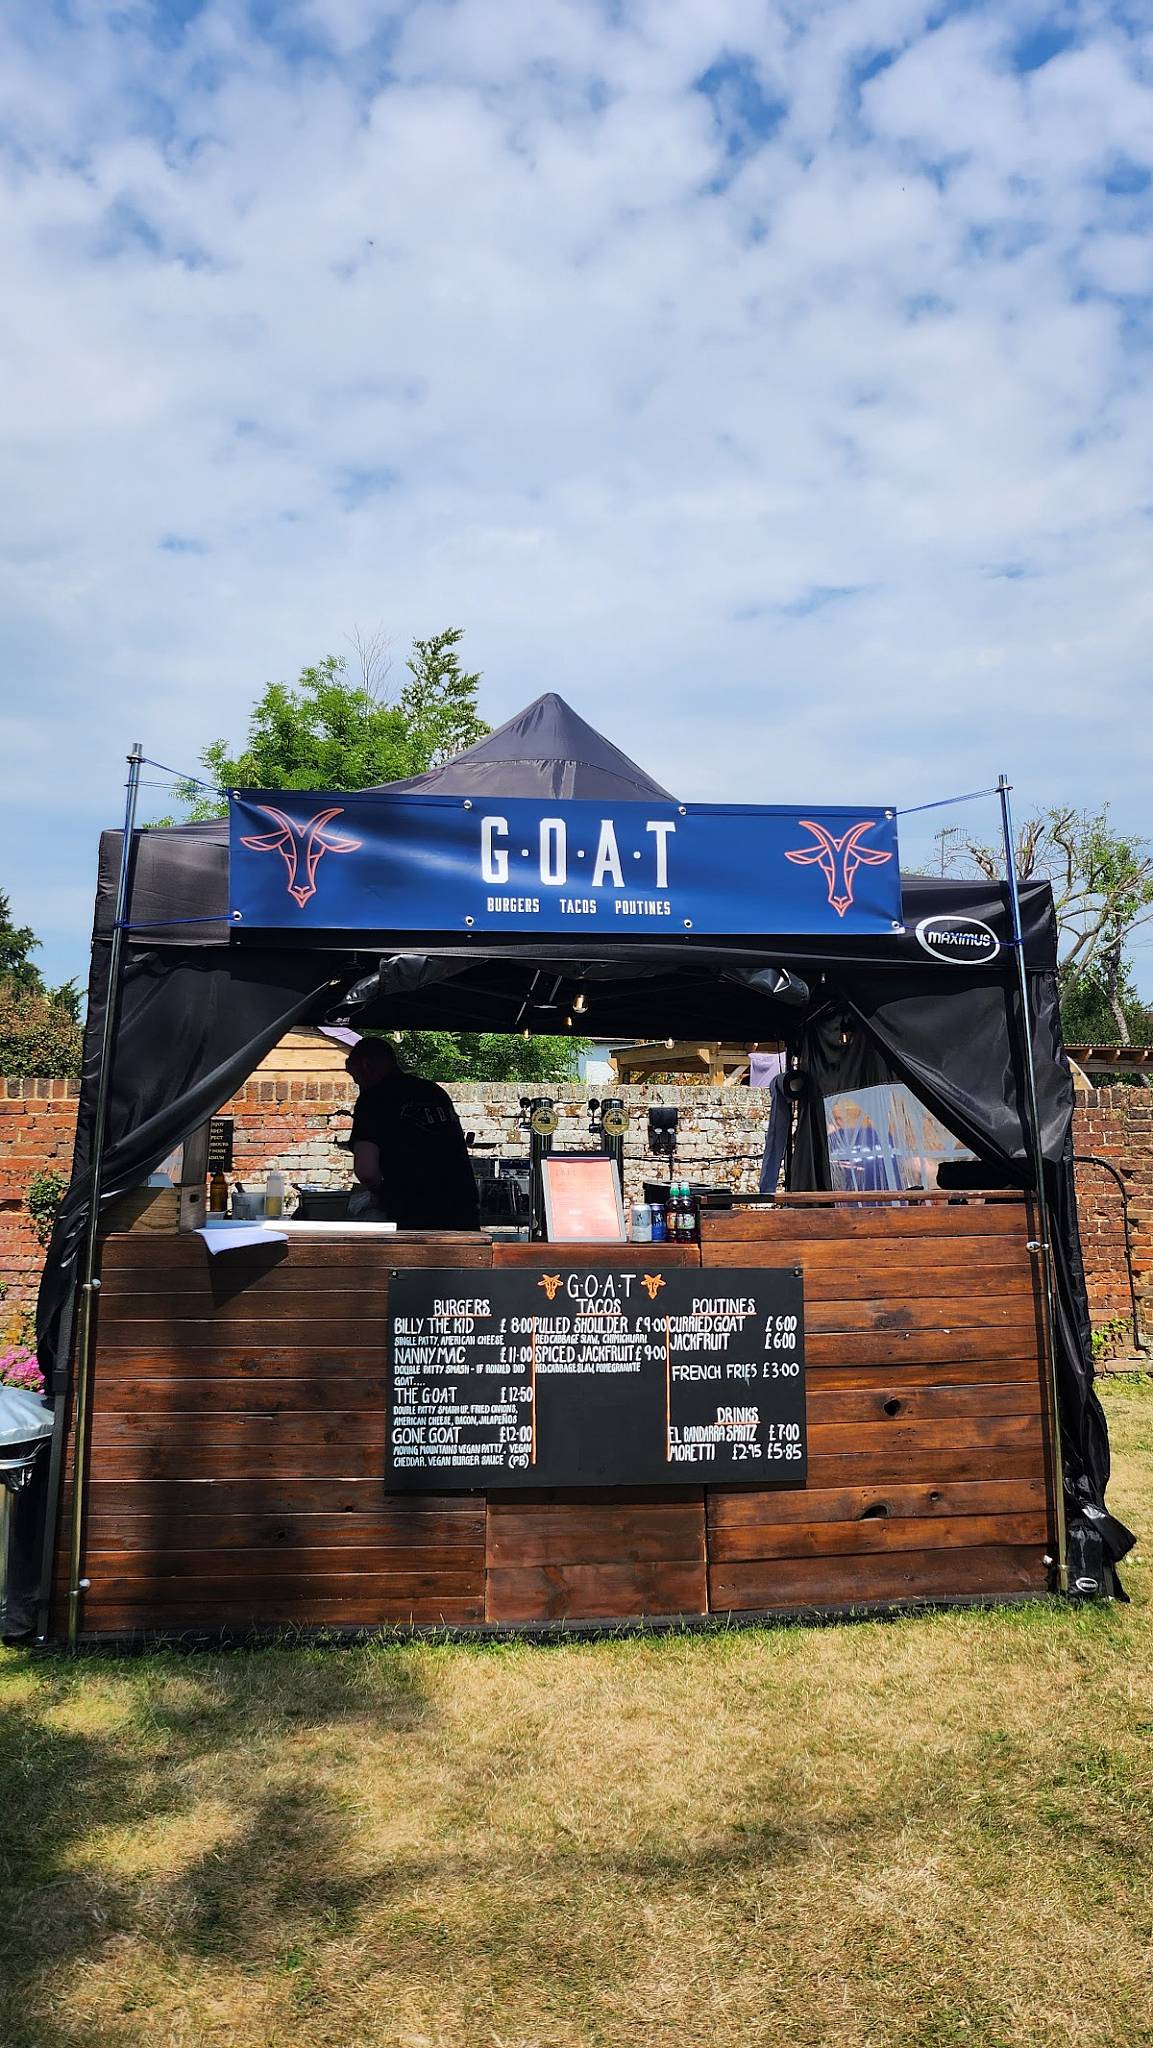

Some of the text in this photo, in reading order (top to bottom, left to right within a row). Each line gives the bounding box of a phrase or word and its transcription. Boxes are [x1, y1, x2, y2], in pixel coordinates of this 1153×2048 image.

[487, 897, 671, 915] BURGERS TACOS POUTINES
[434, 1299, 490, 1315] BURGERS
[576, 1299, 622, 1314] TACOS
[692, 1298, 756, 1314] POUTINES
[394, 1318, 424, 1334] BILLY
[427, 1318, 451, 1334] THE
[454, 1318, 475, 1334] KID
[534, 1317, 571, 1334] PULLED
[573, 1316, 628, 1334] SHOULDER
[669, 1316, 712, 1332] CURRIED
[714, 1316, 746, 1332] GOAT
[394, 1336, 417, 1346] SINGLE
[441, 1335, 475, 1346] AMERICAN
[477, 1335, 504, 1345] CHEESE
[536, 1334, 549, 1344] RED
[550, 1334, 579, 1344] CABBAGE
[669, 1333, 731, 1351] JACKFRUIT
[394, 1347, 436, 1364] NANNY
[437, 1346, 467, 1364] MAC
[535, 1345, 575, 1363] SPICED
[577, 1344, 634, 1363] JACKFRUIT
[394, 1365, 421, 1375] DOUBLE
[423, 1365, 445, 1374] PATTY
[445, 1364, 470, 1375] SMASH
[476, 1364, 484, 1374] IF
[485, 1364, 511, 1375] RONALD
[513, 1363, 526, 1373] DID
[535, 1363, 547, 1374] RED
[547, 1363, 577, 1374] CABBAGE
[672, 1365, 722, 1381] FRENCH
[726, 1363, 758, 1379] FRIES
[394, 1387, 419, 1404] THE
[393, 1406, 416, 1415] DOUBLE
[417, 1405, 437, 1415] PATTY
[471, 1404, 490, 1415] FRIED
[717, 1407, 759, 1422] DRINKS
[393, 1416, 427, 1427] AMERICAN
[392, 1427, 426, 1444] GONE
[428, 1426, 462, 1444] GOAT
[669, 1426, 682, 1443] EL
[683, 1424, 725, 1442] BANDARRA
[726, 1424, 757, 1441] SPRITZ
[420, 1444, 458, 1455] MOUNTAINS
[458, 1444, 481, 1454] VEGAN
[508, 1443, 532, 1454] VEGAN
[669, 1443, 715, 1461] MORETTI
[427, 1456, 451, 1466] VEGAN
[451, 1455, 480, 1466] BURGER
[481, 1454, 504, 1466] SAUCE
[508, 1453, 530, 1469] (PB)
